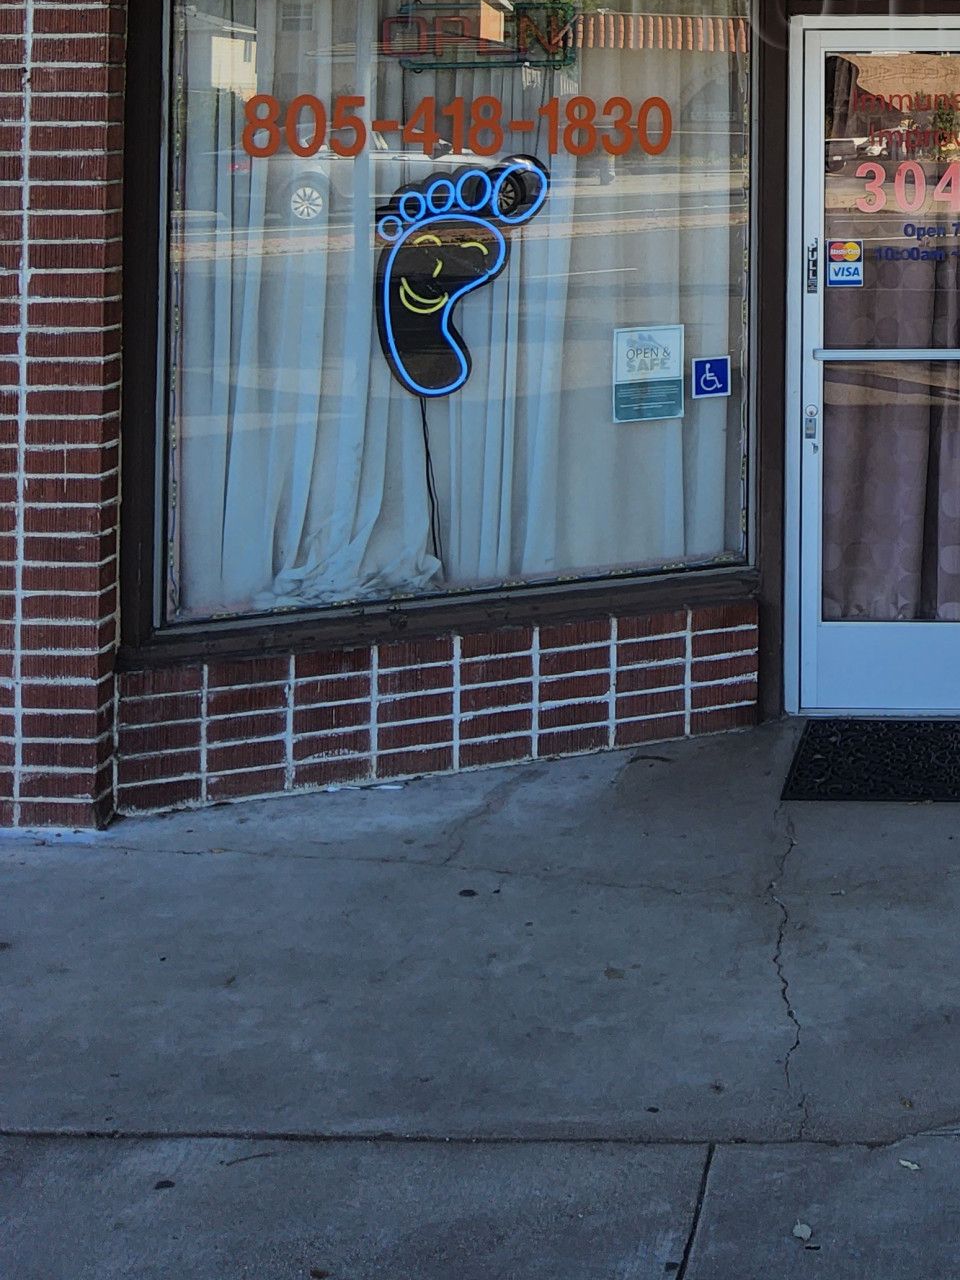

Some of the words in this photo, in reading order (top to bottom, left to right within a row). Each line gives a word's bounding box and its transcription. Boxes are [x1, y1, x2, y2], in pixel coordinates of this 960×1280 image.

[242, 94, 673, 158] 805-418-1830
[903, 223, 947, 240] Open
[832, 266, 860, 277] VISA
[625, 347, 659, 360] OPEN
[662, 345, 671, 357] &
[625, 359, 671, 373] SAFE
